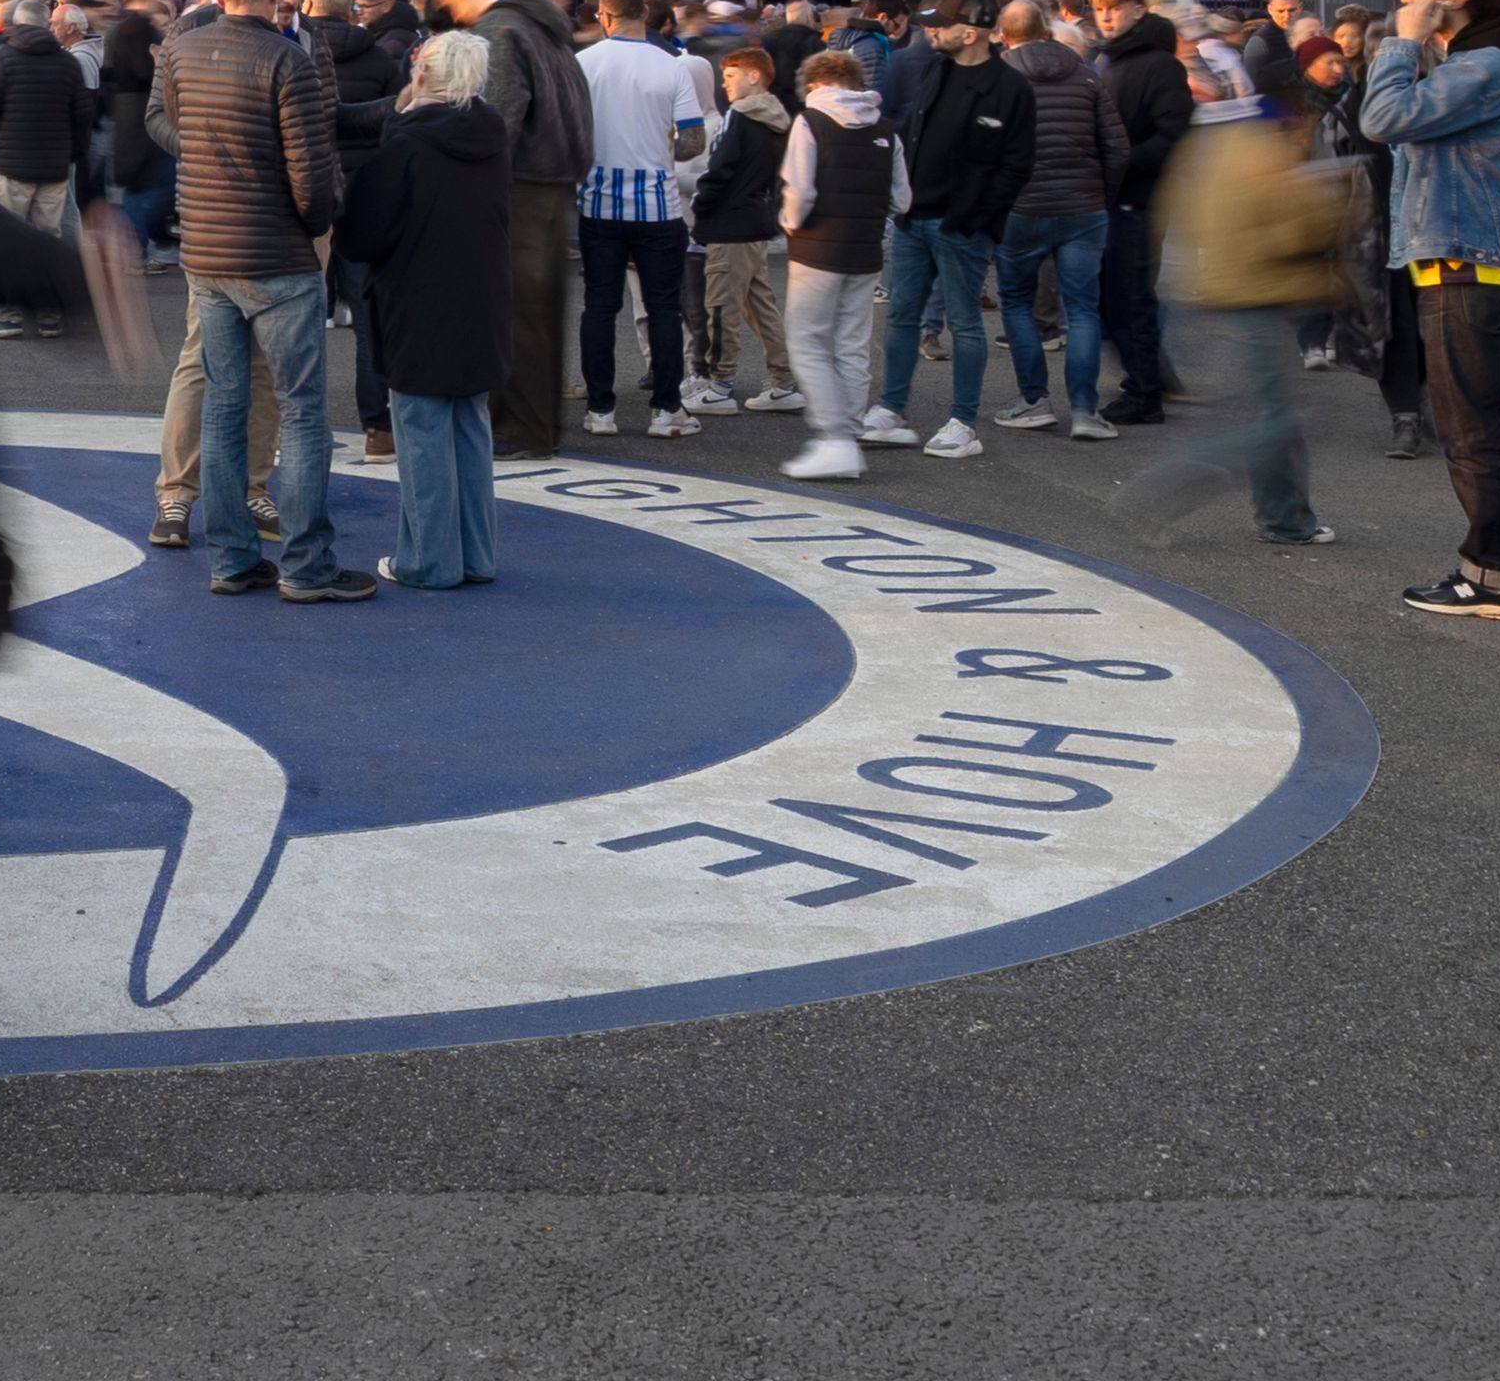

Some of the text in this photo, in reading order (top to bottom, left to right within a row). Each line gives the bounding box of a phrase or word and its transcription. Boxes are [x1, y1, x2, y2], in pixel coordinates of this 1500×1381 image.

[494, 466, 1101, 615] IGHTON
[954, 647, 1173, 684] &
[597, 710, 1174, 909] HOVE
